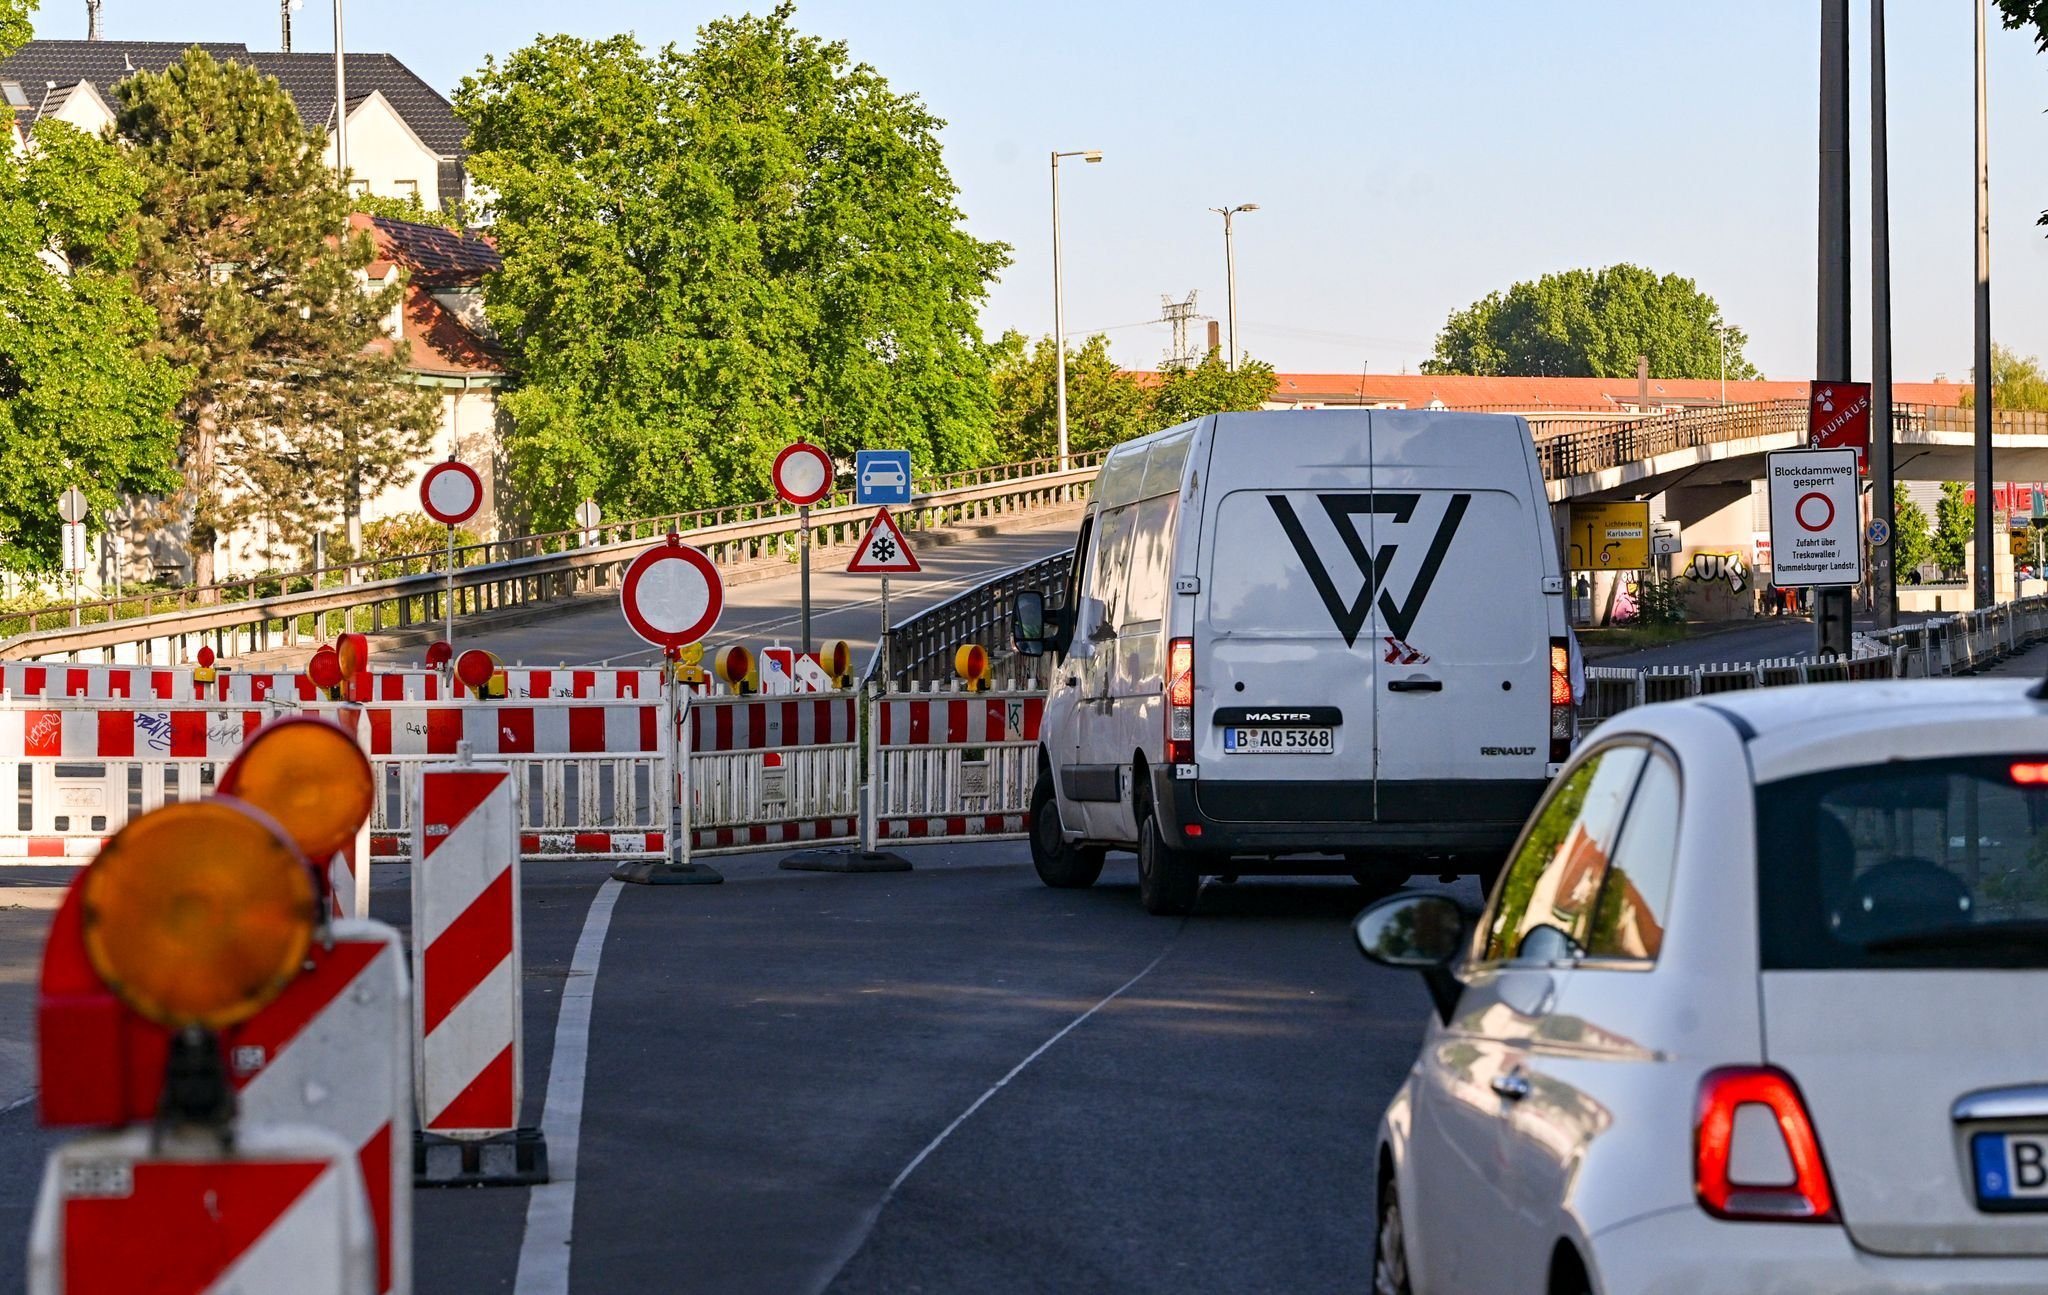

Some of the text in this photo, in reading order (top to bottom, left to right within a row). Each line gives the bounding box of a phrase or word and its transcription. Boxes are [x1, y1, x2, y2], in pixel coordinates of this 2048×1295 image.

[1811, 398, 1868, 443] BAUHAUS
[1775, 466, 1852, 476] Blockdammweg
[1793, 477, 1835, 488] gesperrt
[1796, 538, 1836, 547] Zufahrt über
[1792, 550, 1836, 559] Treskowallee
[1777, 562, 1857, 572] Rummelsburger Landstr.
[1245, 713, 1311, 721] MASTER
[1236, 731, 1248, 747] B
[1260, 731, 1283, 747] AQ
[1286, 731, 1330, 747] 5368
[1480, 746, 1537, 756] RENAULT
[2014, 1142, 2047, 1187] B
